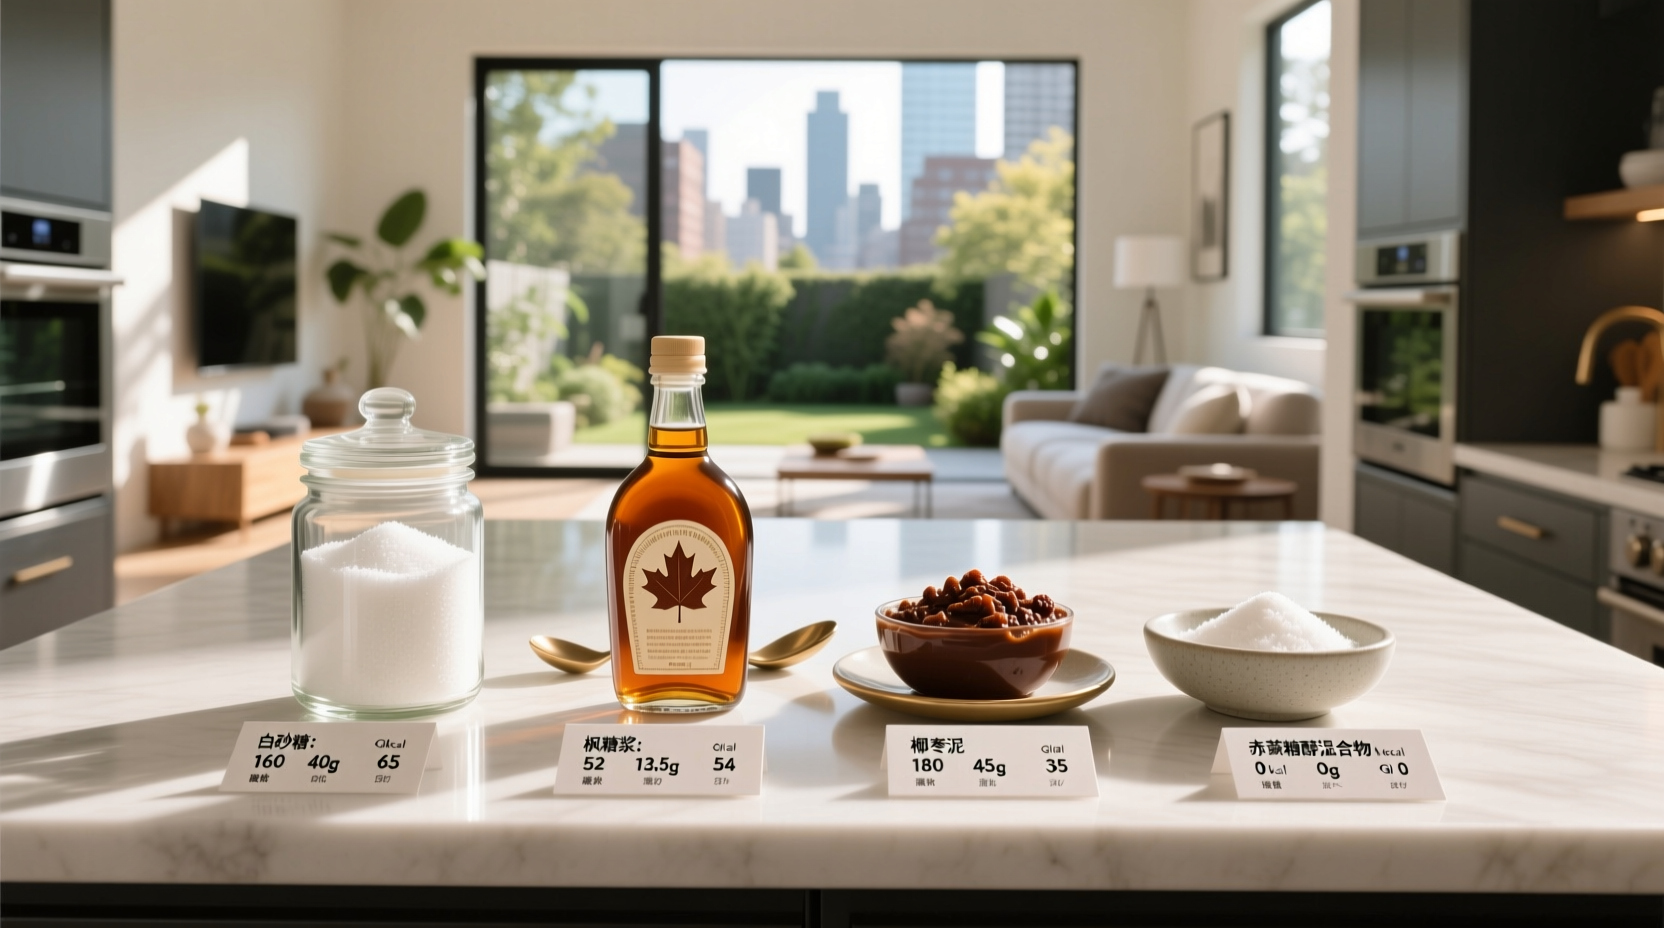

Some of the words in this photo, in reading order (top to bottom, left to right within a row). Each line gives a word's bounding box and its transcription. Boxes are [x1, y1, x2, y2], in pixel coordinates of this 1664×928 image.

[254, 754, 286, 769] 160
[307, 755, 340, 773] 40g
[377, 755, 401, 769] 65
[582, 756, 605, 771] 52
[635, 757, 680, 776] 13.5g
[713, 757, 736, 771] 54
[912, 758, 944, 772] 180
[973, 759, 1006, 777] 45g
[1045, 759, 1068, 773] 35
[1255, 761, 1266, 775] 0
[1317, 762, 1340, 779] 0g
[1398, 762, 1409, 776] 0
